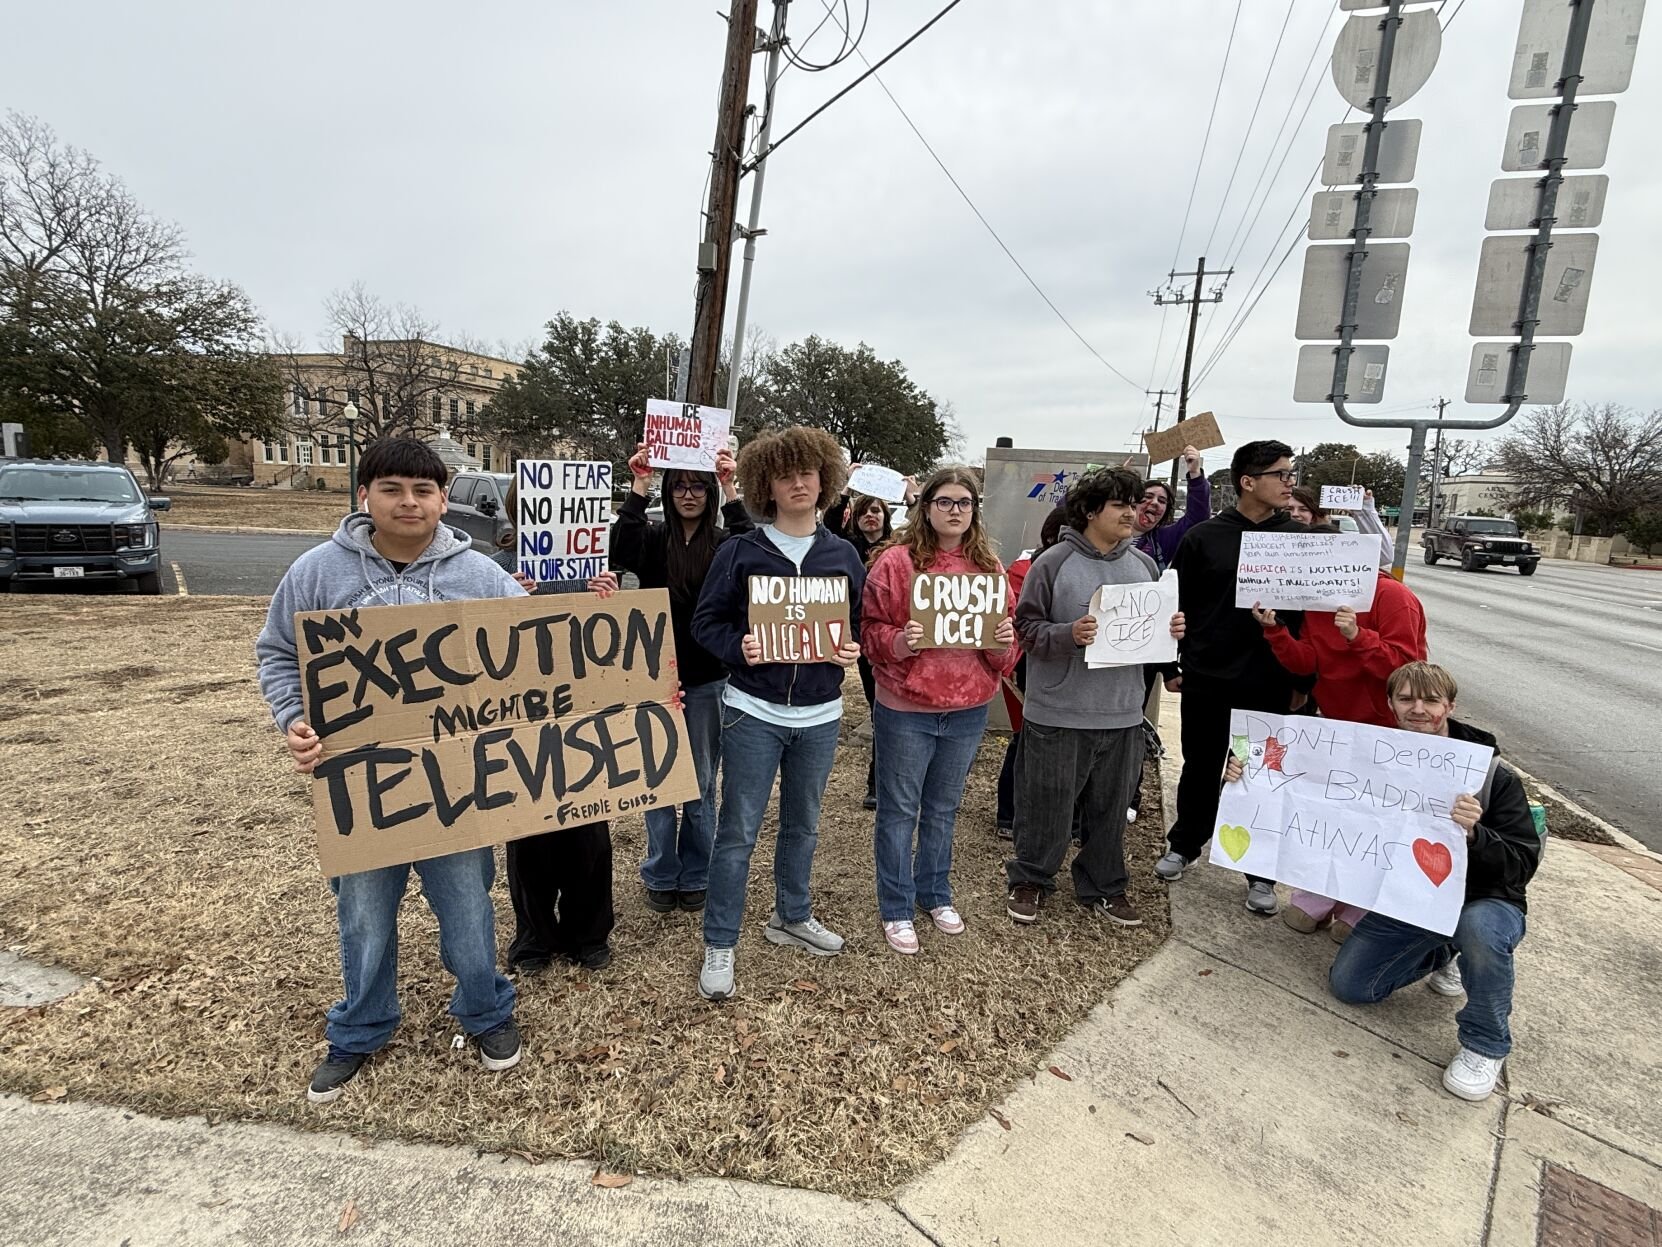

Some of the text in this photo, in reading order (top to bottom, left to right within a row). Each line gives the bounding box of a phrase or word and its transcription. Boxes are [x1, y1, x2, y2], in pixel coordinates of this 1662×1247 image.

[647, 414, 702, 434] INHUMAN
[682, 404, 701, 419] ICE
[646, 429, 701, 449] CALLOUS
[520, 463, 611, 490] NO FEAR
[521, 497, 611, 525] NO HATE
[521, 527, 607, 557] NO ICE
[1244, 533, 1265, 542] STOP
[521, 556, 608, 581] IN OUR STATE
[1239, 563, 1372, 574] AMERICA IS NOTHING
[364, 576, 395, 591] BYOND
[751, 577, 847, 605] NO HUMAN
[912, 573, 1007, 614] CRUSH
[784, 605, 806, 621] IS
[1130, 589, 1162, 618] NO
[302, 608, 363, 655] MY
[934, 613, 984, 647] ICE!
[1111, 621, 1152, 642] ICE
[306, 608, 668, 739] EXECUTION
[313, 701, 679, 835] TELEVISED
[1324, 769, 1453, 821] BADDIE
